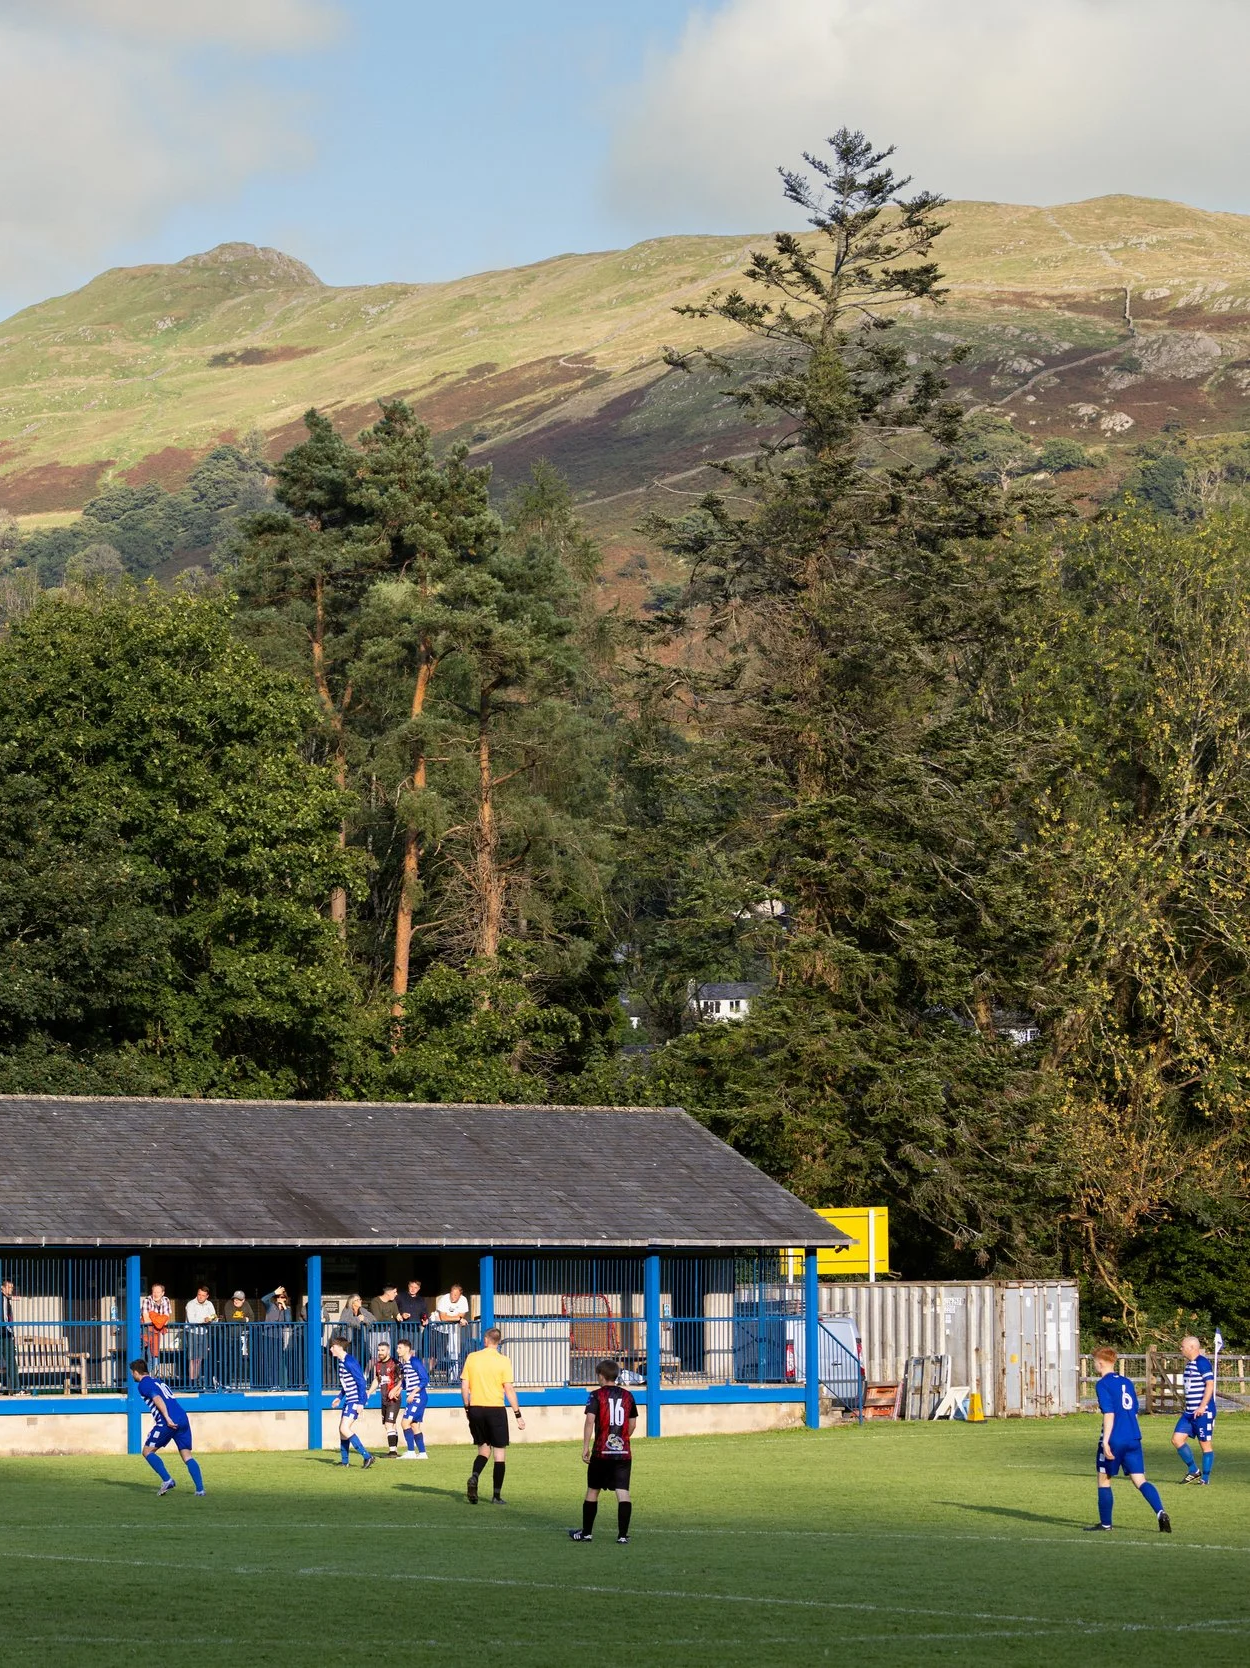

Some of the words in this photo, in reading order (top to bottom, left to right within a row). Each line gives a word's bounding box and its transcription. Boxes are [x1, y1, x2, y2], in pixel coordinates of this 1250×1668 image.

[154, 1381, 176, 1399] 10
[1121, 1384, 1133, 1410] 6
[608, 1398, 625, 1426] 16
